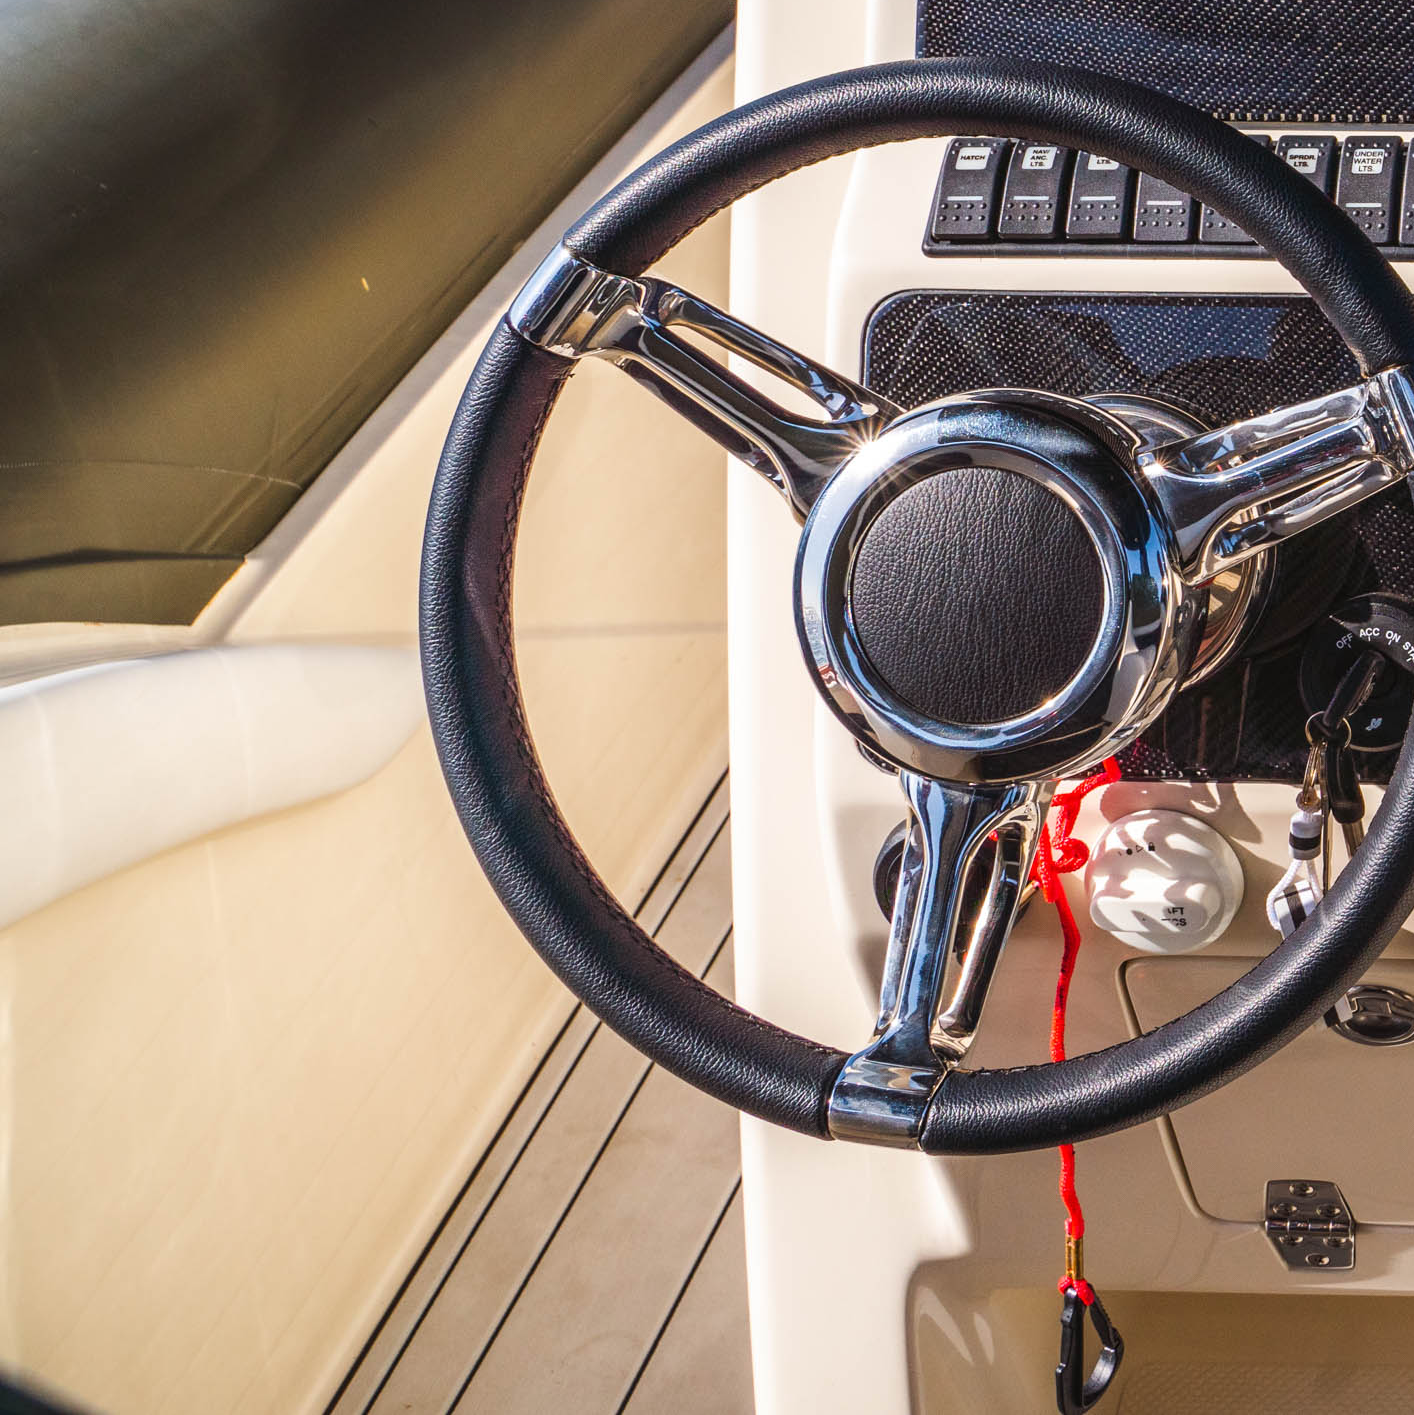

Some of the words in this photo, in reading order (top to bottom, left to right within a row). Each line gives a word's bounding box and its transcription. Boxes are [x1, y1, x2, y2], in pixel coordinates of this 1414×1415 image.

[1336, 632, 1353, 649] OFF
[1360, 627, 1380, 638] ACC
[1385, 630, 1402, 643] ON
